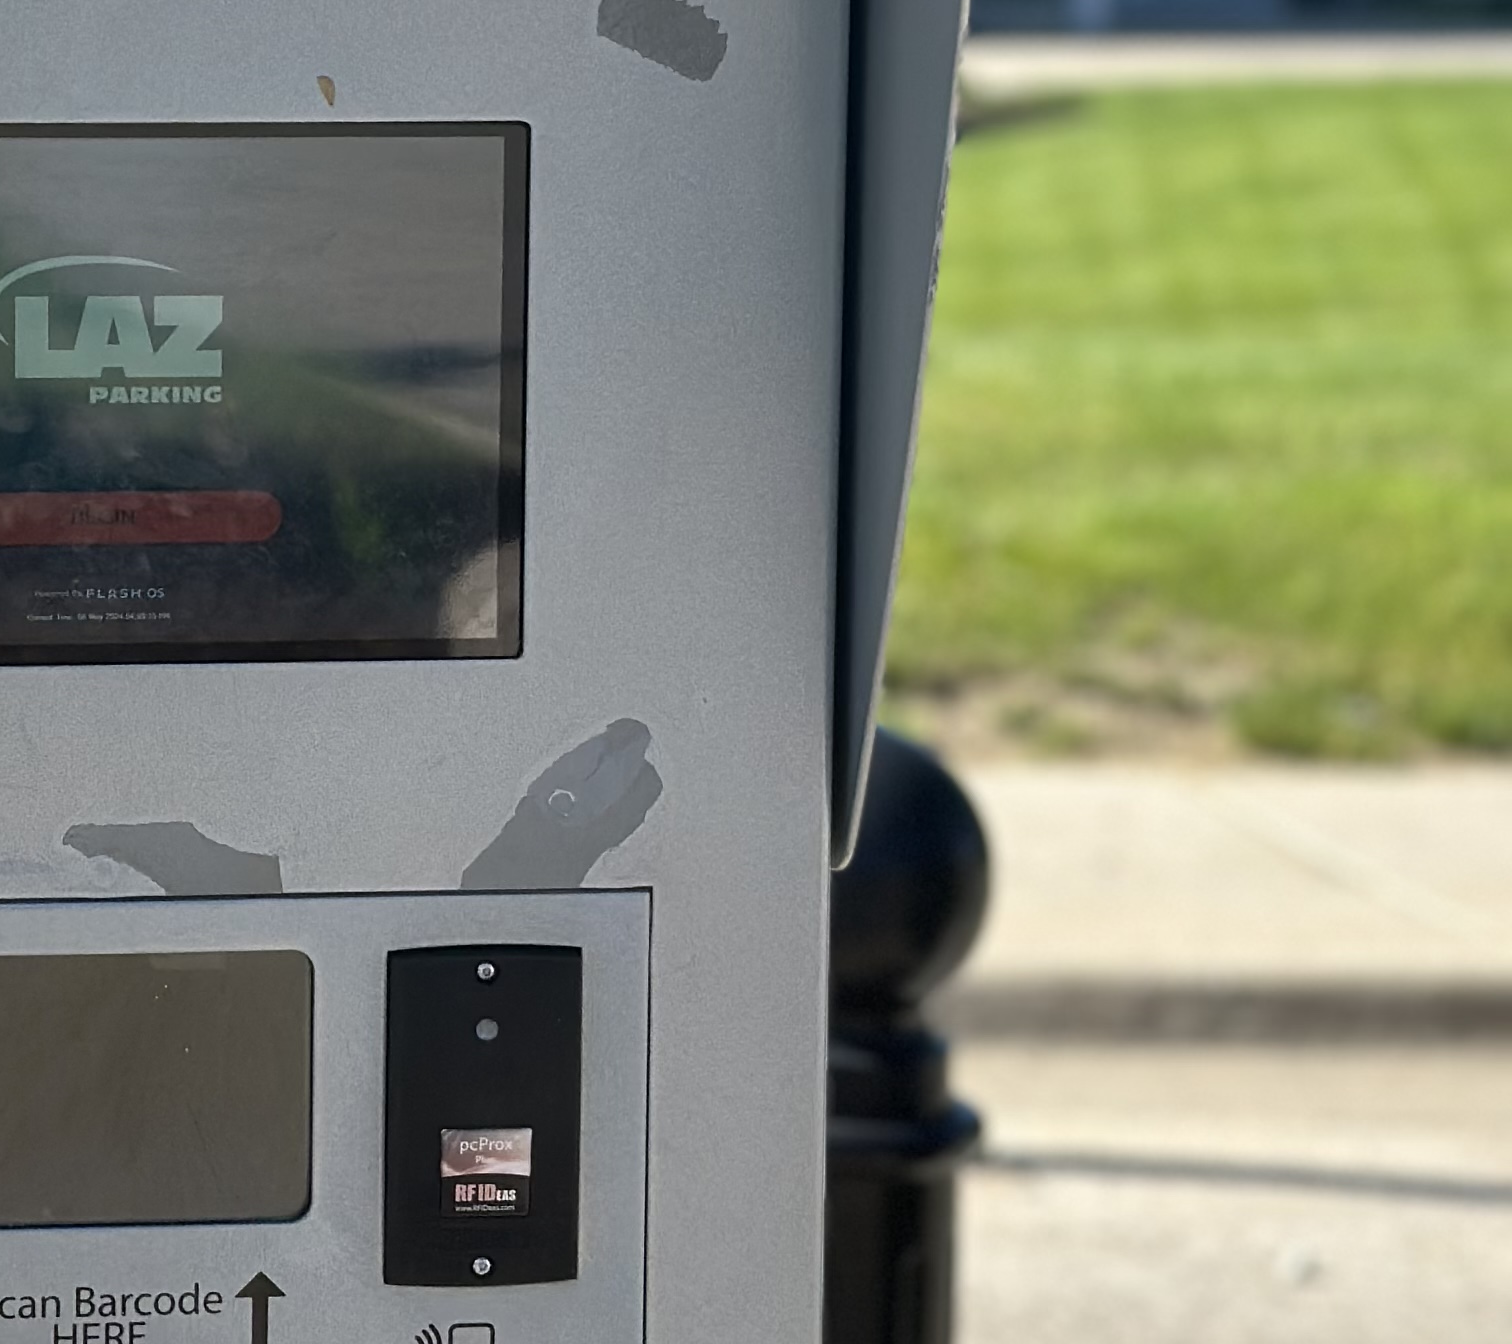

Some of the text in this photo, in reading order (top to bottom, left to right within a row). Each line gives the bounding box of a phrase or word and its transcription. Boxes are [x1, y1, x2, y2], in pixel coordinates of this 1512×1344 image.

[14, 296, 223, 379] LAZ
[90, 386, 222, 404] PARKING
[87, 588, 141, 598] FLASH
[460, 1137, 512, 1154] pcProx
[76, 1283, 222, 1317] Barcode
